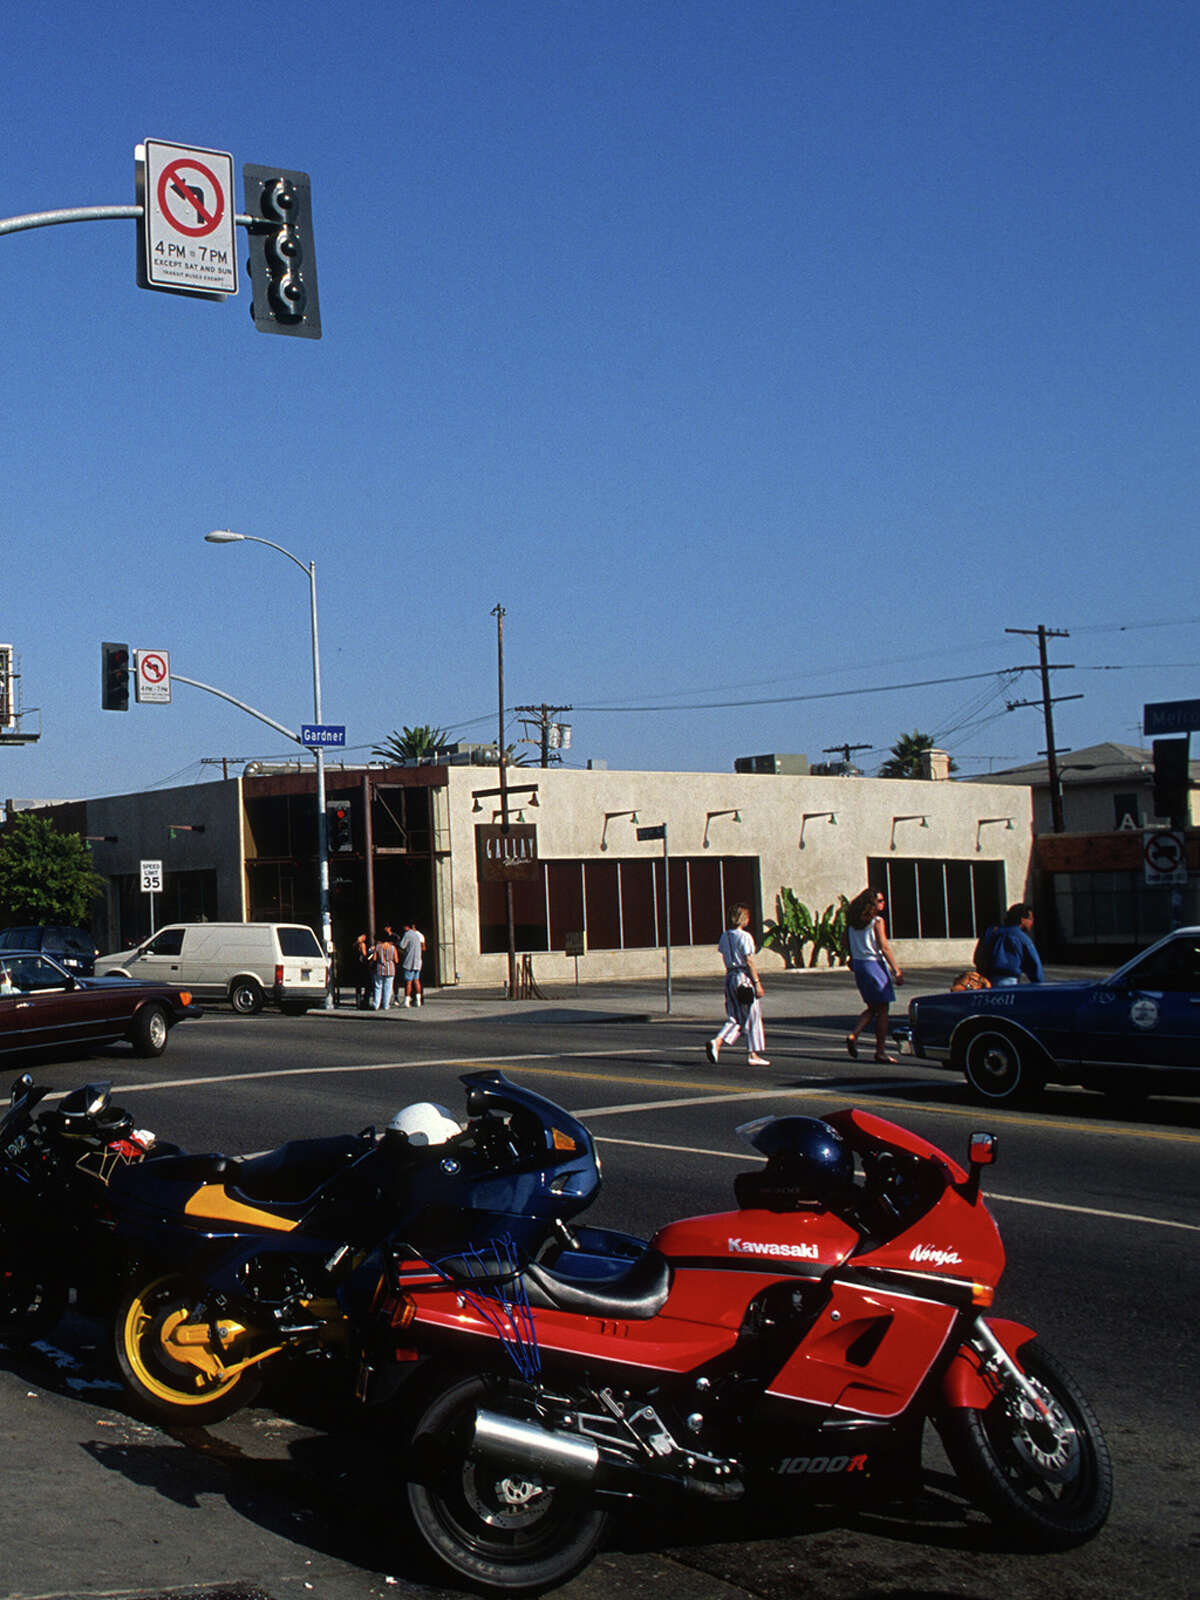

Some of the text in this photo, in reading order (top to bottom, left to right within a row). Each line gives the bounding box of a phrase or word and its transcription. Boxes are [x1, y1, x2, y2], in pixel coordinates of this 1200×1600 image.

[155, 240, 165, 255] 4
[154, 258, 232, 275] EXCEPT SAT AND SUN
[304, 729, 343, 741] Gardner
[143, 876, 160, 889] 35
[728, 1237, 819, 1259] Kawasaki
[909, 1243, 963, 1266] Ninja
[778, 1454, 869, 1475] 1000R
